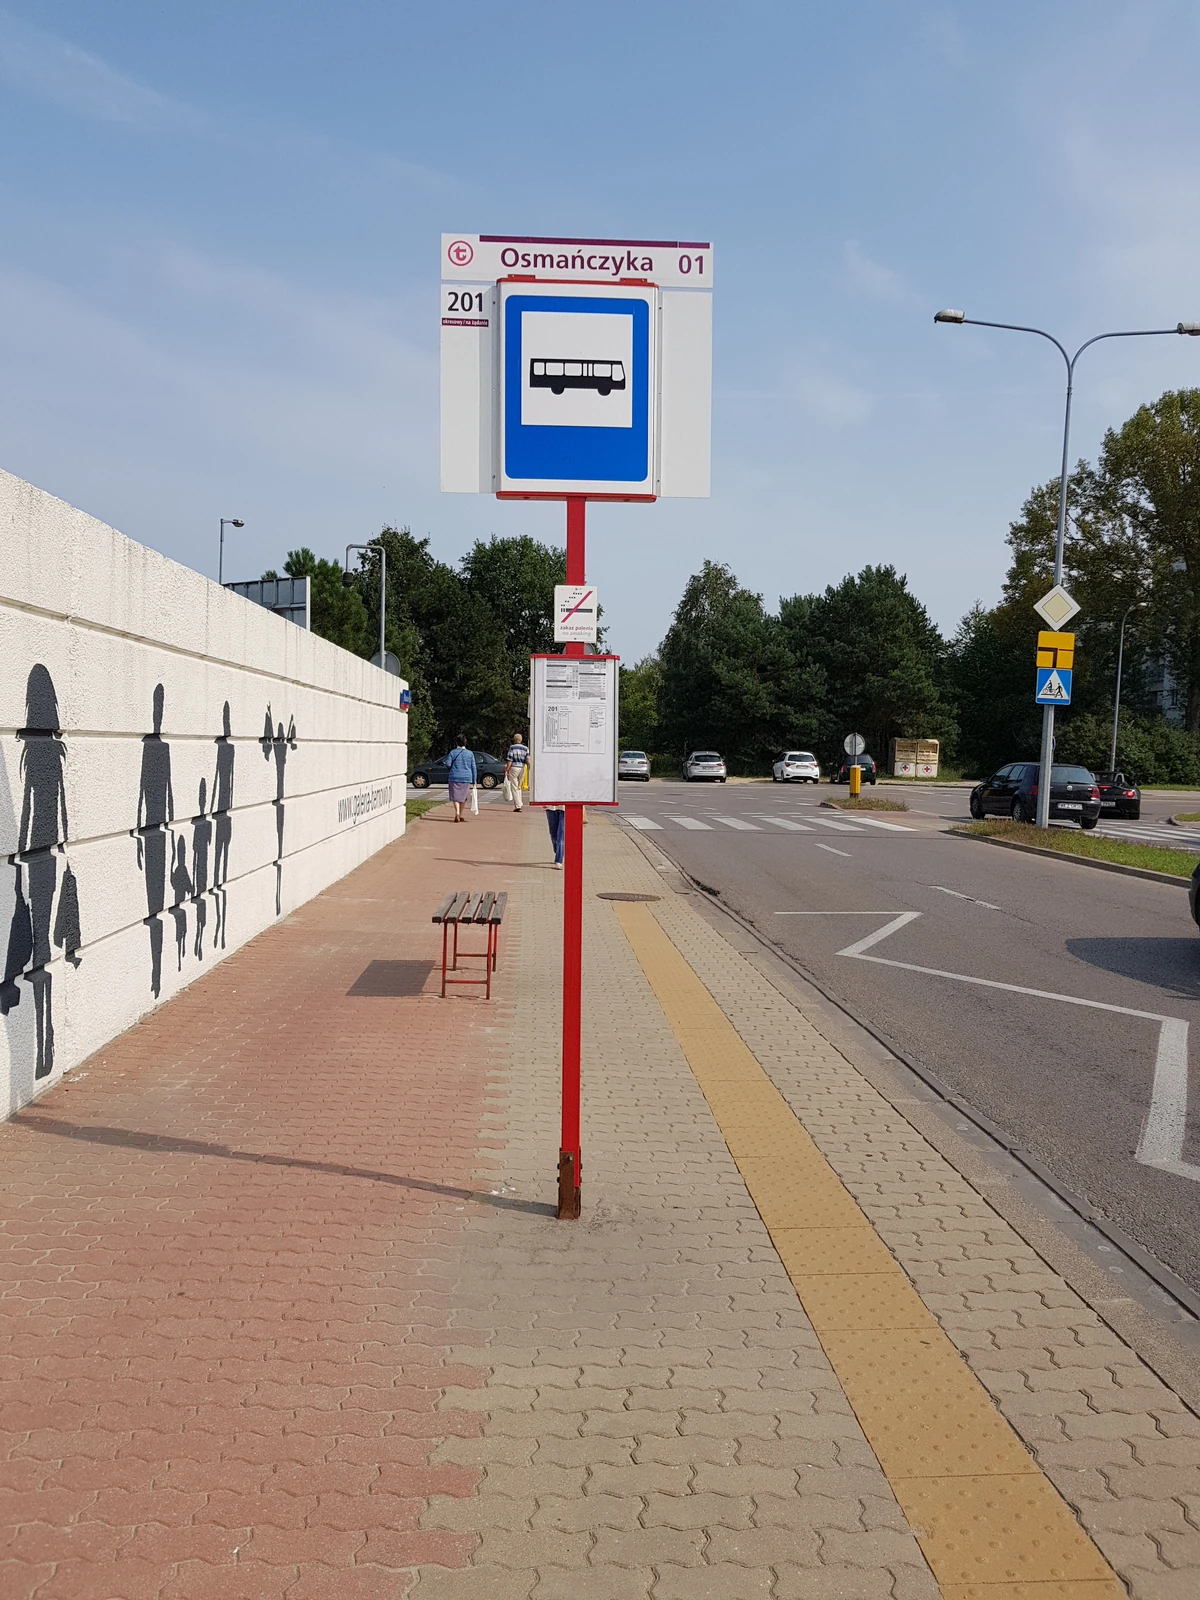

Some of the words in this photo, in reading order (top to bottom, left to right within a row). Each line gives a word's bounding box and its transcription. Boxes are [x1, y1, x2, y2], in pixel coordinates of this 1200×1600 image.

[500, 247, 653, 276] Osmańczyka
[678, 254, 704, 274] 01
[447, 291, 483, 313] 201
